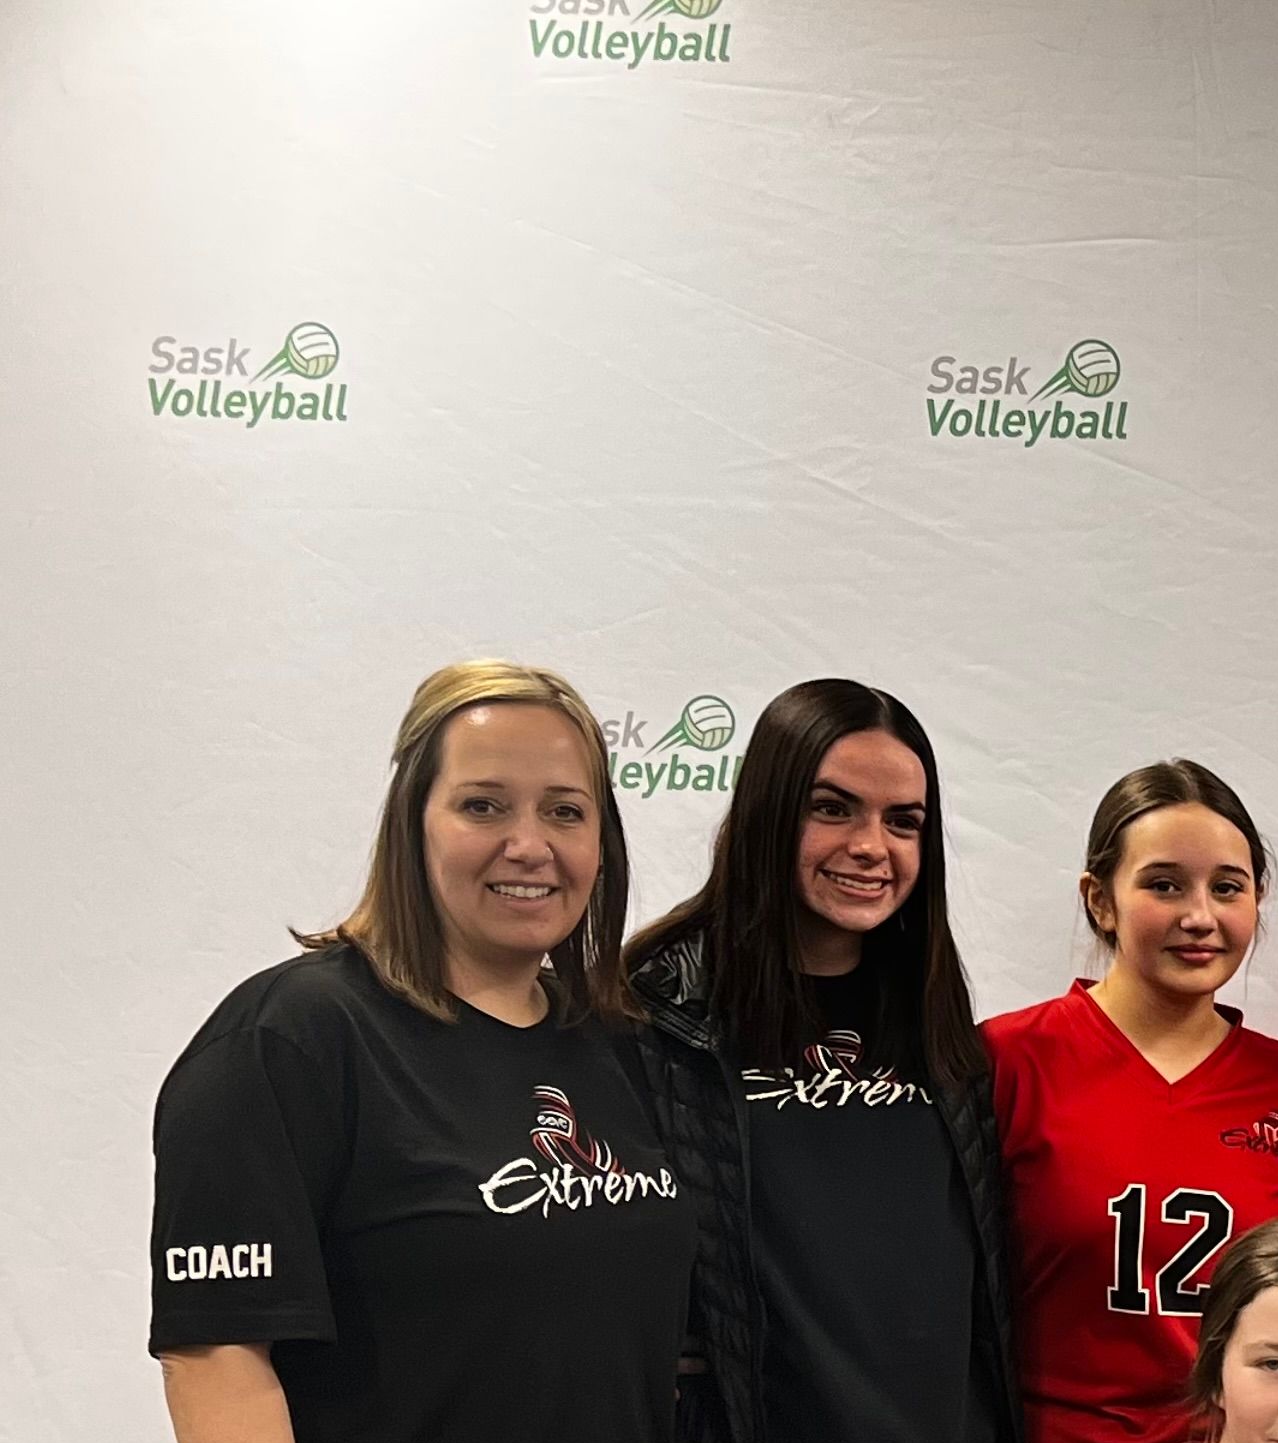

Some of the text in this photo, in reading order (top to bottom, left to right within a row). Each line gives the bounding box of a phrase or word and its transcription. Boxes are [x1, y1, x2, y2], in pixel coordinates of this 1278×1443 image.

[529, 19, 731, 70] Volleyball
[148, 335, 250, 376] Sask
[926, 355, 1031, 395] Sask
[148, 377, 348, 429] Volleyball
[926, 398, 1128, 448] Volleyball
[601, 710, 648, 748] sk
[608, 751, 744, 799] leyball
[740, 1066, 933, 1111] Extrem
[477, 1156, 679, 1219] Extreme
[166, 1243, 272, 1282] COACH
[1107, 1183, 1234, 1317] 12
